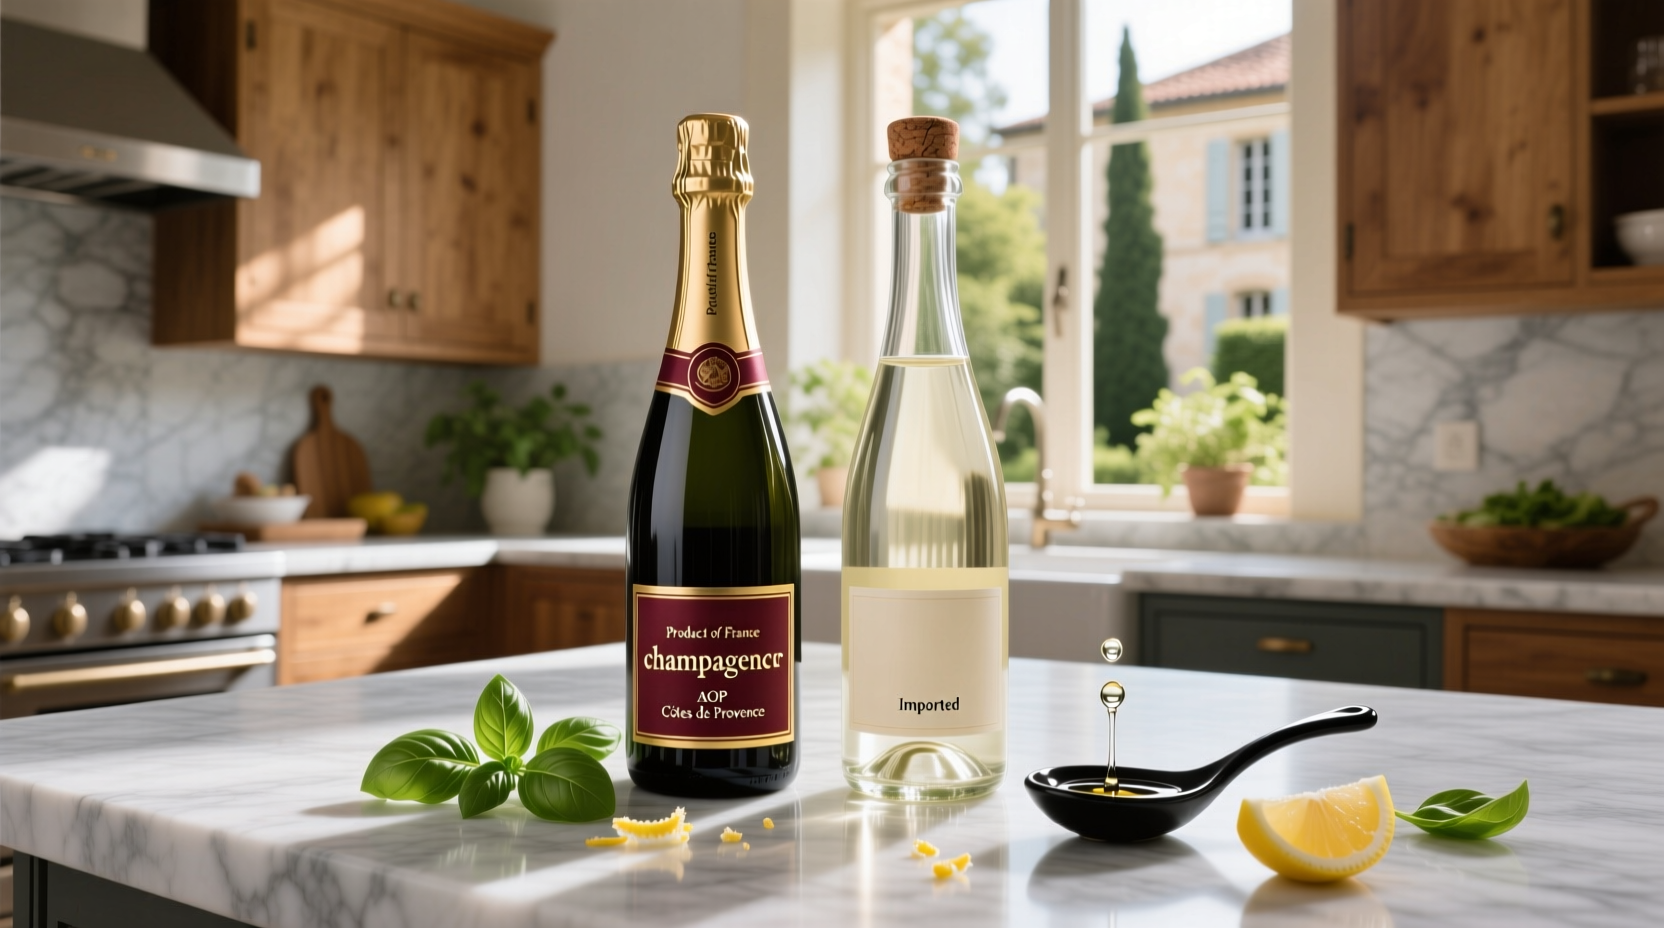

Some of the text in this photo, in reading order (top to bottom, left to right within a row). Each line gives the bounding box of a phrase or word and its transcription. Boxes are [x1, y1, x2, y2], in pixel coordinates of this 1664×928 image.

[710, 626, 723, 639] of
[724, 626, 761, 639] France
[697, 690, 728, 703] AOP
[696, 705, 711, 719] de
[714, 706, 765, 719] Provence
[898, 697, 960, 714] Imported
